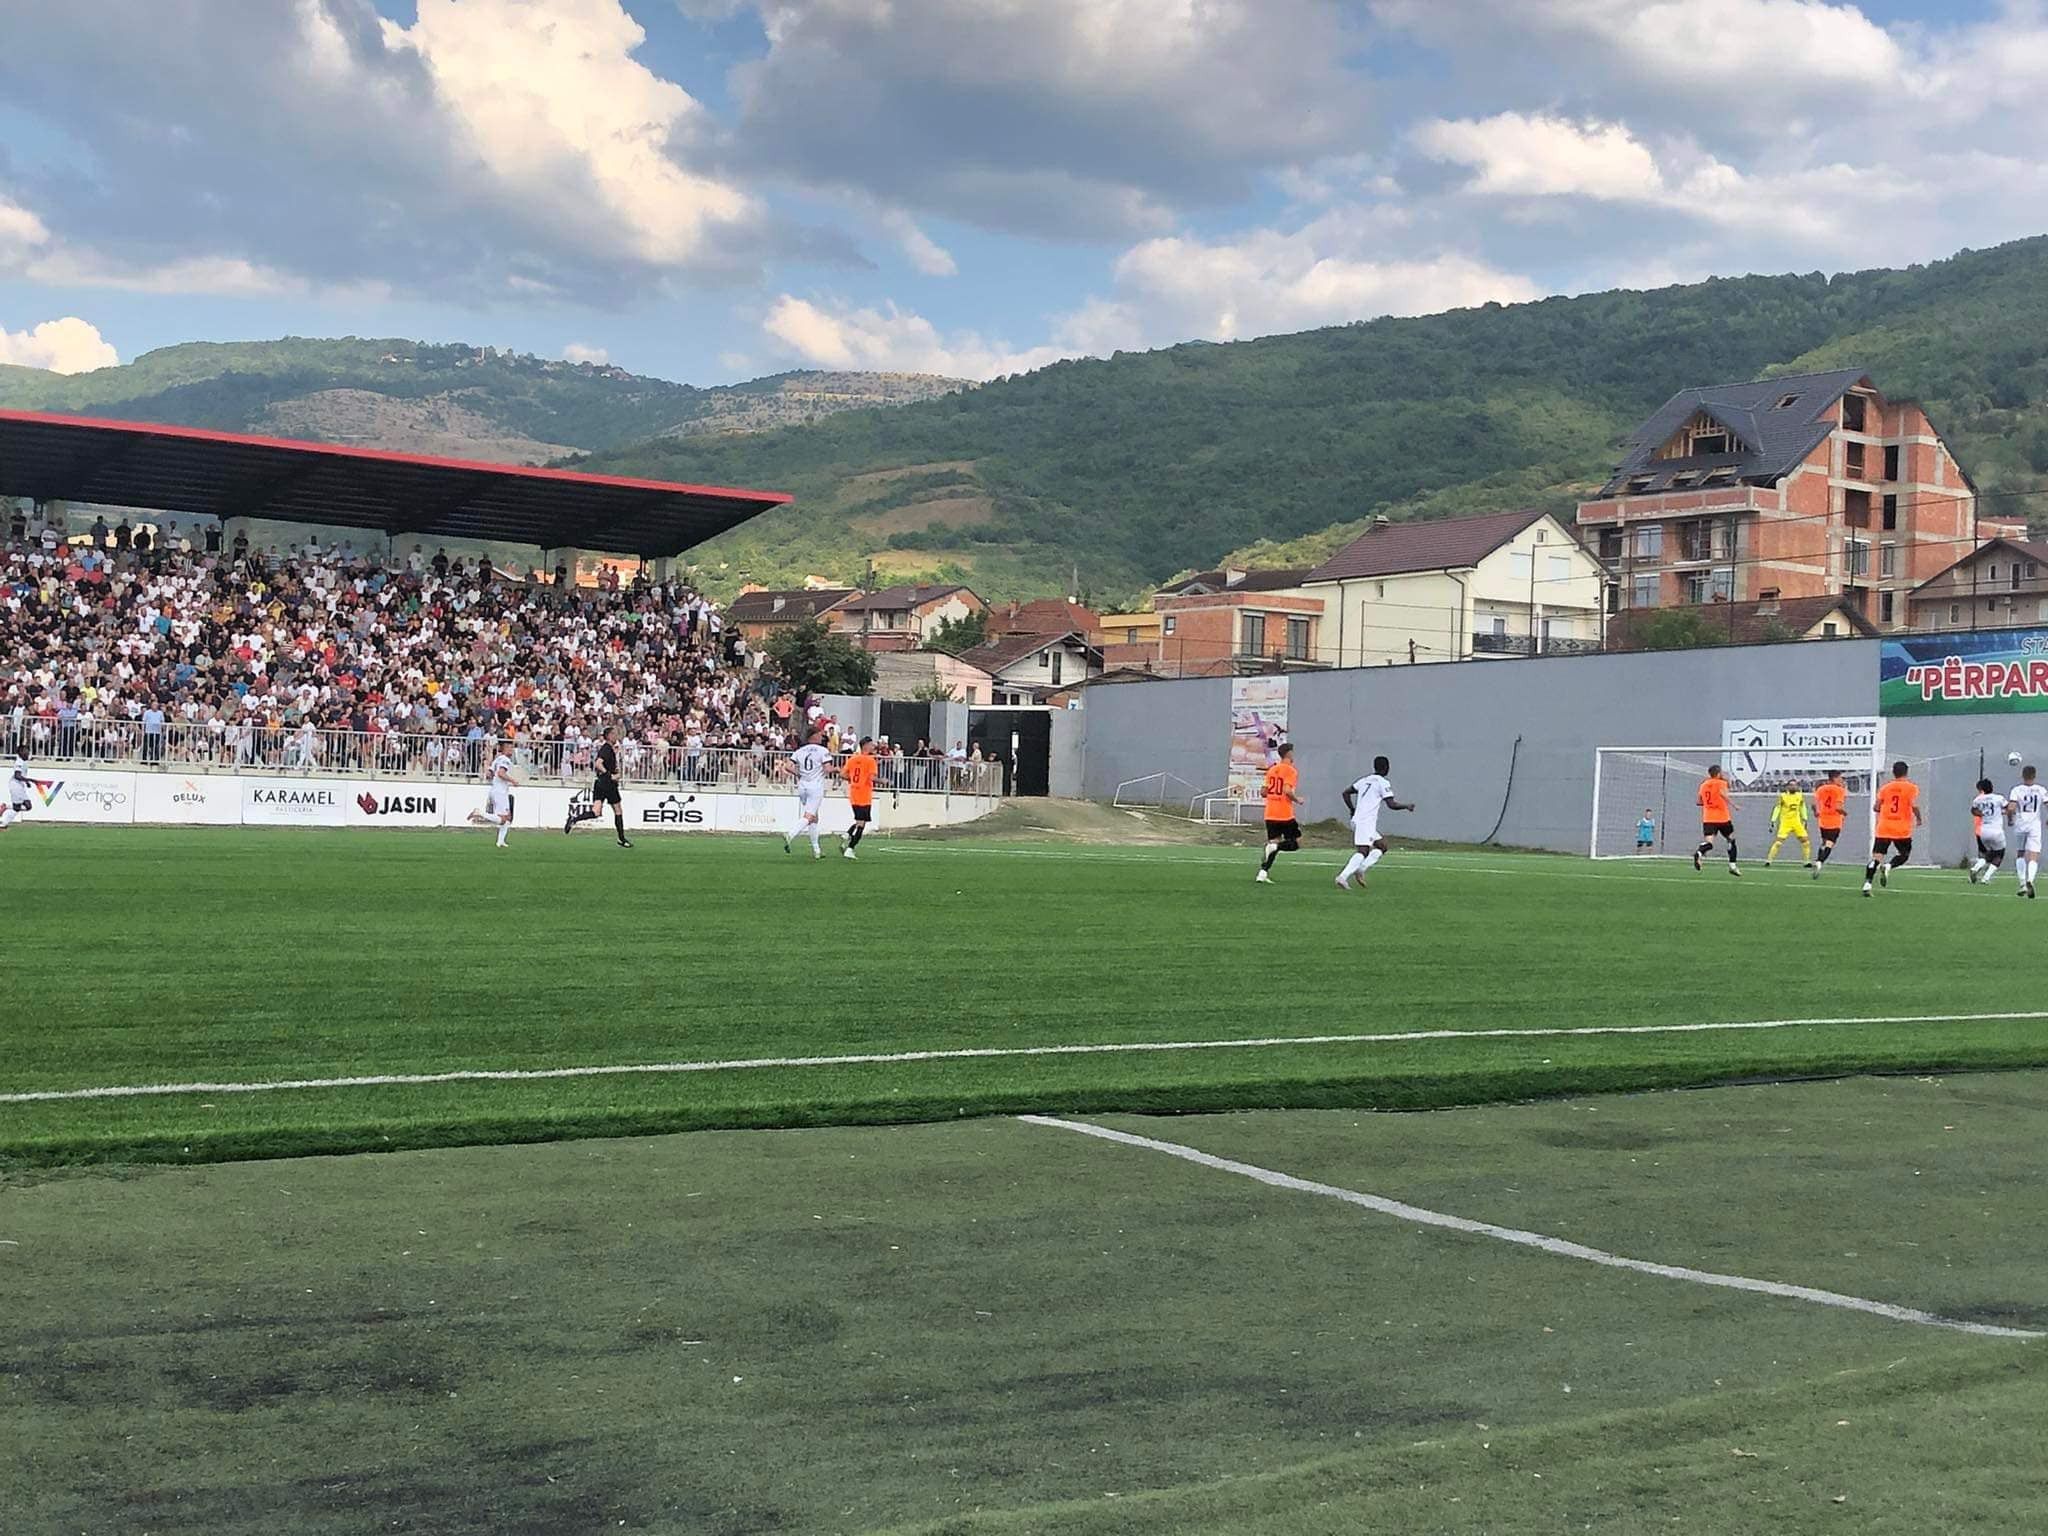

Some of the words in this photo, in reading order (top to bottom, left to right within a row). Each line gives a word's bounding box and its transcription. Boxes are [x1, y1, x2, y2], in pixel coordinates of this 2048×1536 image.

[804, 753, 813, 771] 6
[853, 767, 861, 783] 8
[1267, 776, 1284, 796] 20
[1361, 782, 1372, 799] 7
[65, 789, 127, 811] vertigo
[173, 792, 206, 804] DELUX
[253, 789, 336, 805] KARAMEL
[378, 796, 437, 815] JASIN
[1705, 791, 1713, 805] 2
[1824, 795, 1832, 809] 4
[1890, 795, 1900, 813] 3
[2022, 794, 2038, 813] 21
[642, 809, 704, 824] ERIS
